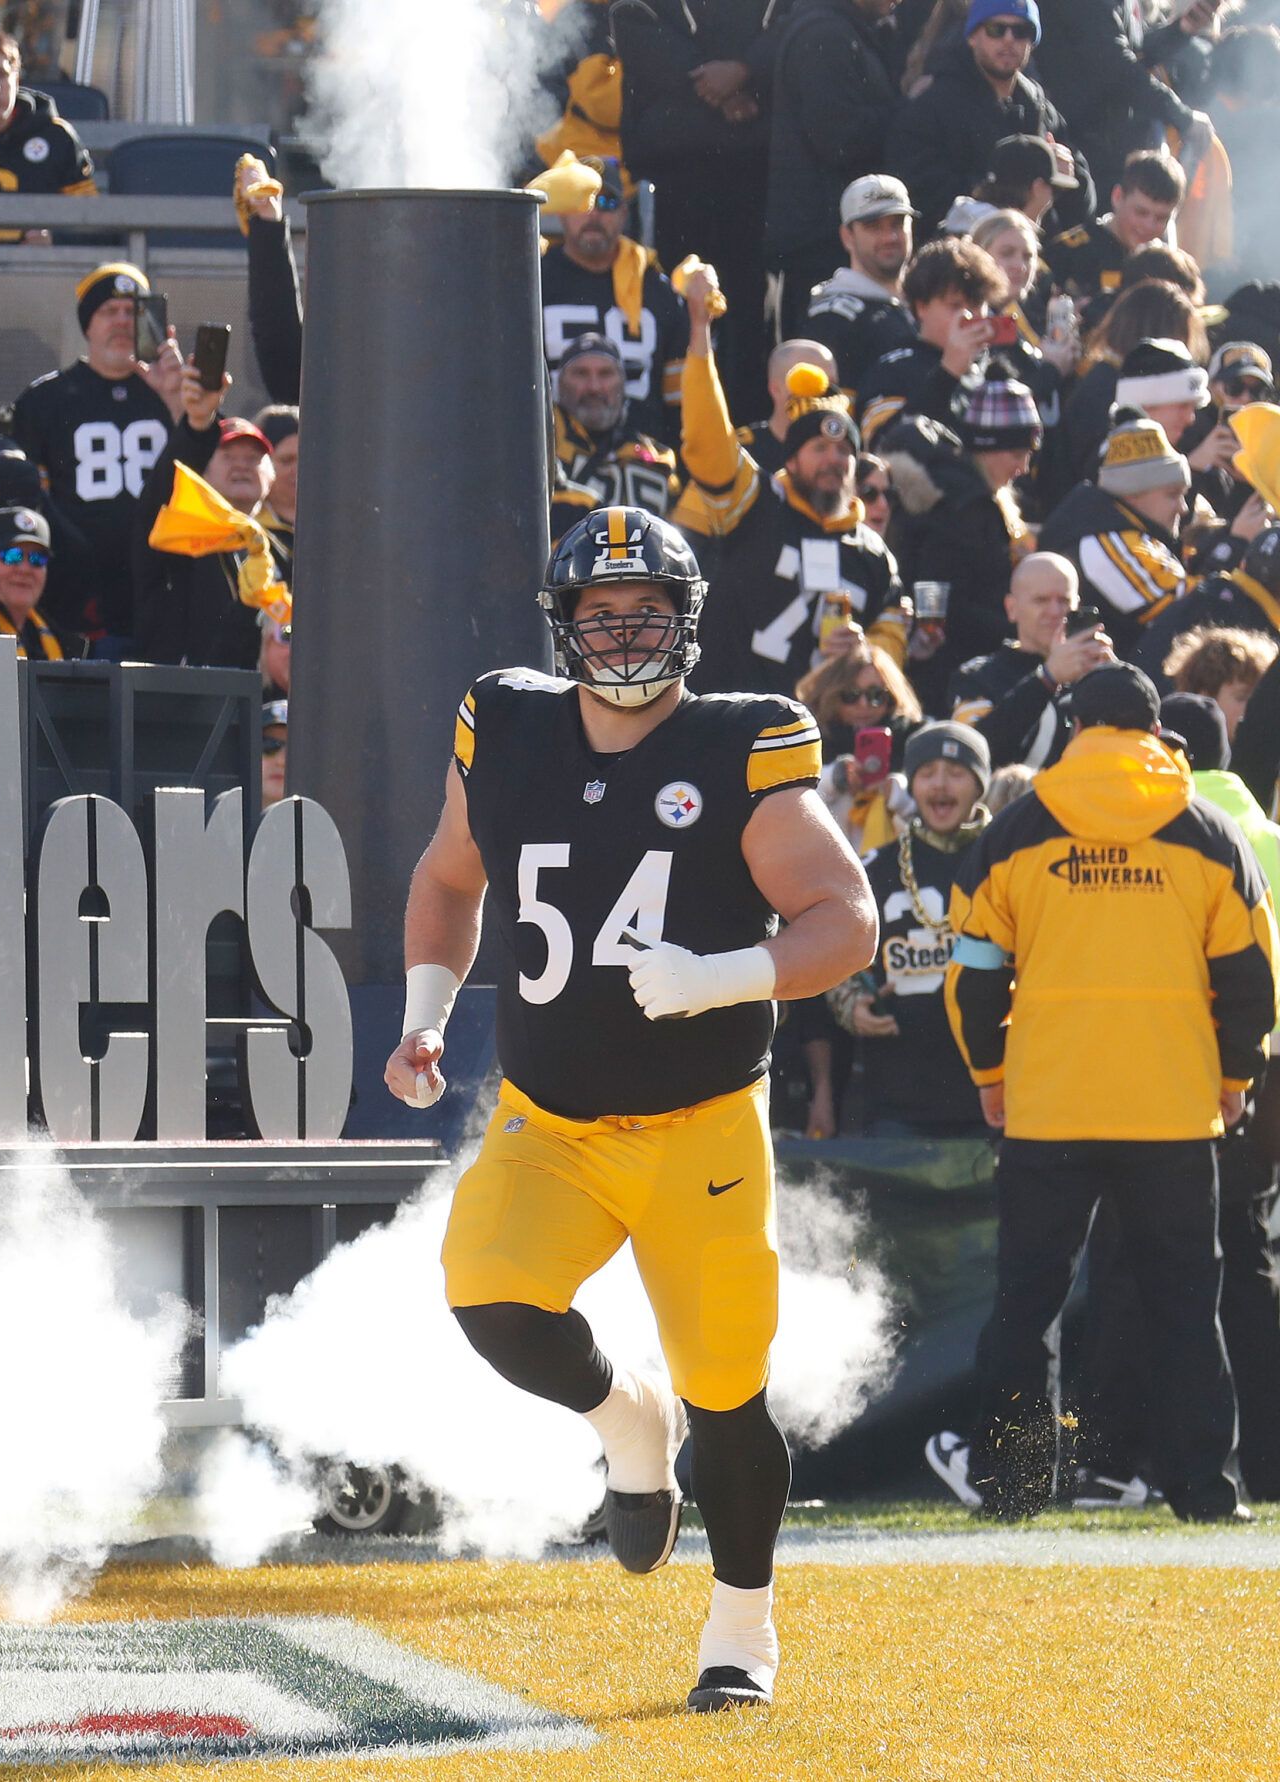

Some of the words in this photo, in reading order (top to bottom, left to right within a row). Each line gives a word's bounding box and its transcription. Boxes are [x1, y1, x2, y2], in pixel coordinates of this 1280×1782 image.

[73, 419, 168, 502] 88
[605, 561, 634, 570] Steelers
[1069, 844, 1128, 864] ALLIED
[1069, 860, 1164, 885] UNIVERSAL
[516, 842, 673, 1005] 54
